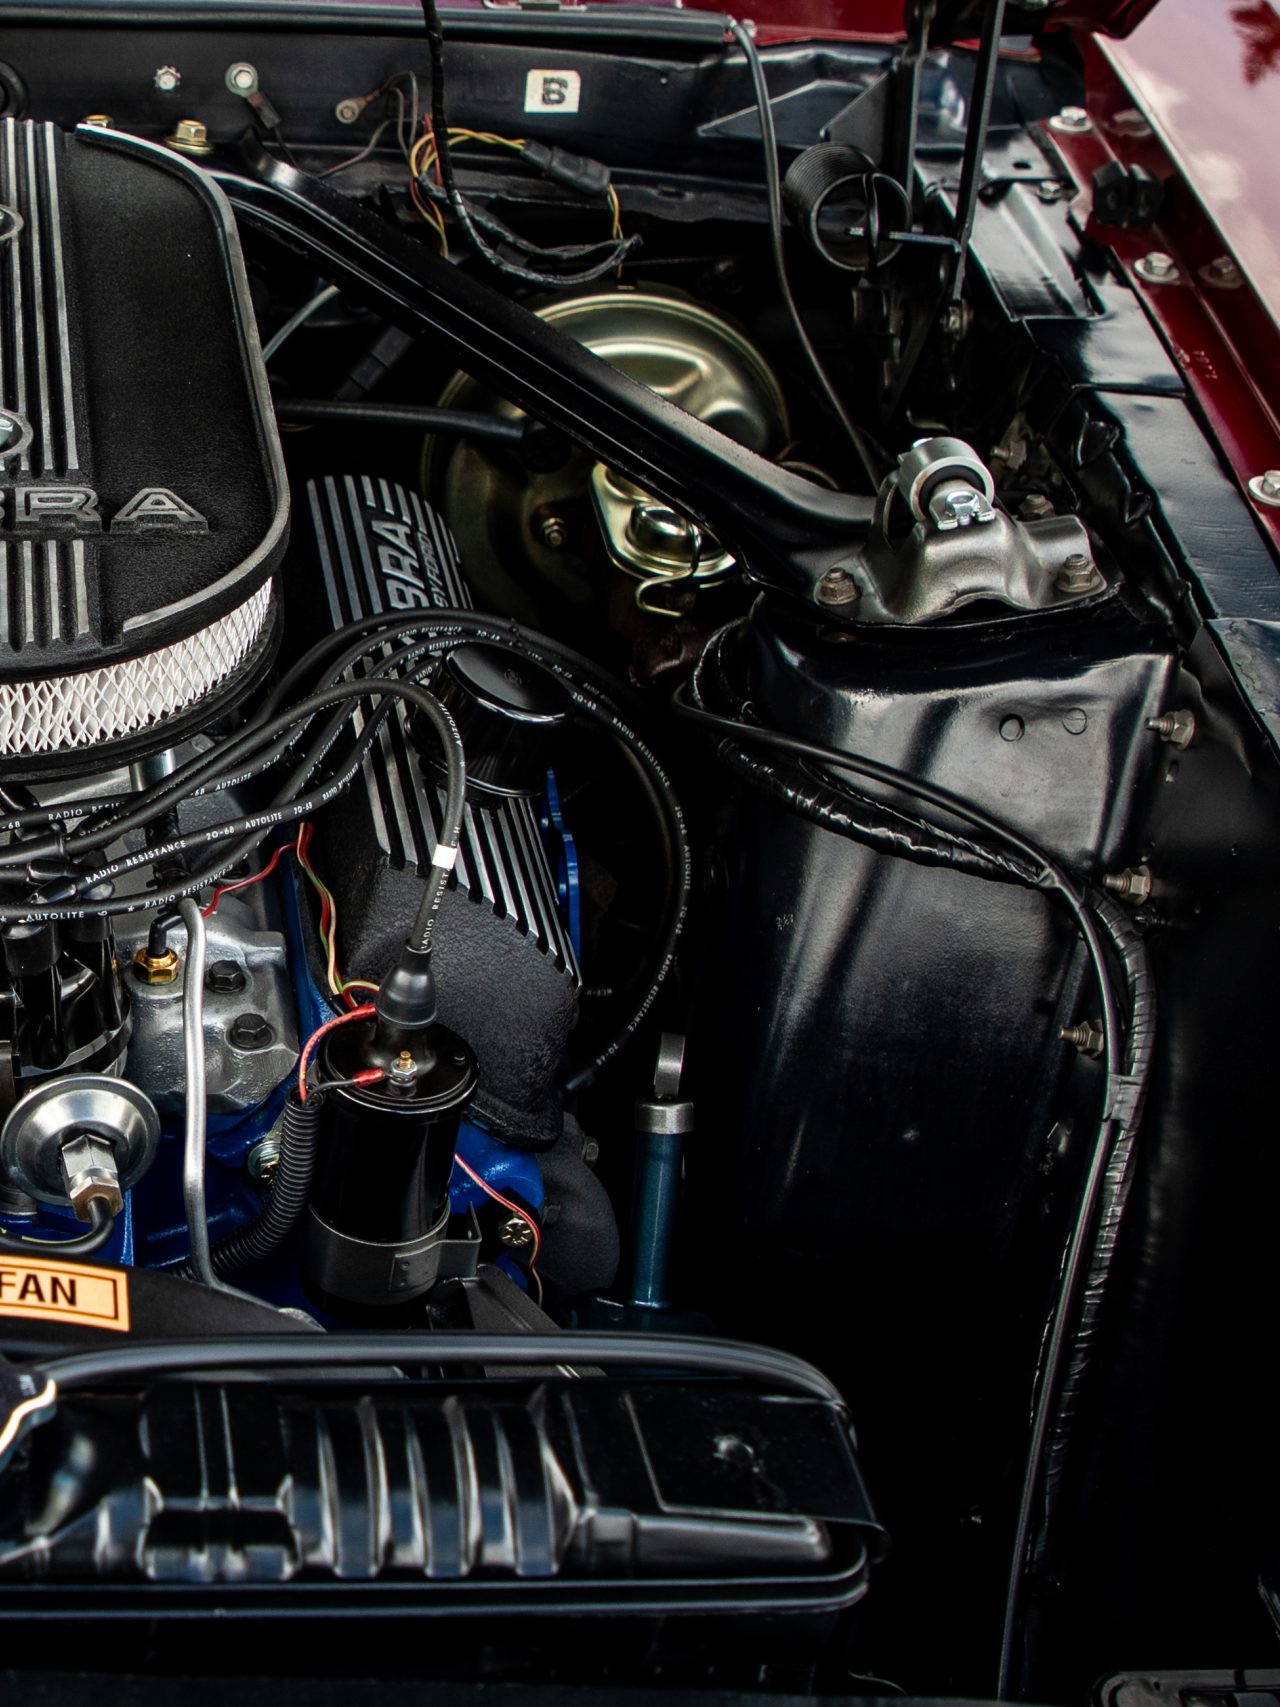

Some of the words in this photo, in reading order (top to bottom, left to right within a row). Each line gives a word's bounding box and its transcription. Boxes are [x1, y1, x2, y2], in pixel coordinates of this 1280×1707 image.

[612, 716, 635, 740] RADIO
[637, 740, 671, 788] RESISTANCE
[48, 808, 83, 821] RADIO
[85, 863, 120, 885] RADIO
[125, 839, 187, 867] RESISTANCE
[245, 811, 283, 830] AUTOLITE
[26, 911, 85, 924] AUTOLITE
[143, 893, 177, 910] RADIO
[657, 953, 674, 982] RADIO
[626, 984, 660, 1033] RESISTANCE
